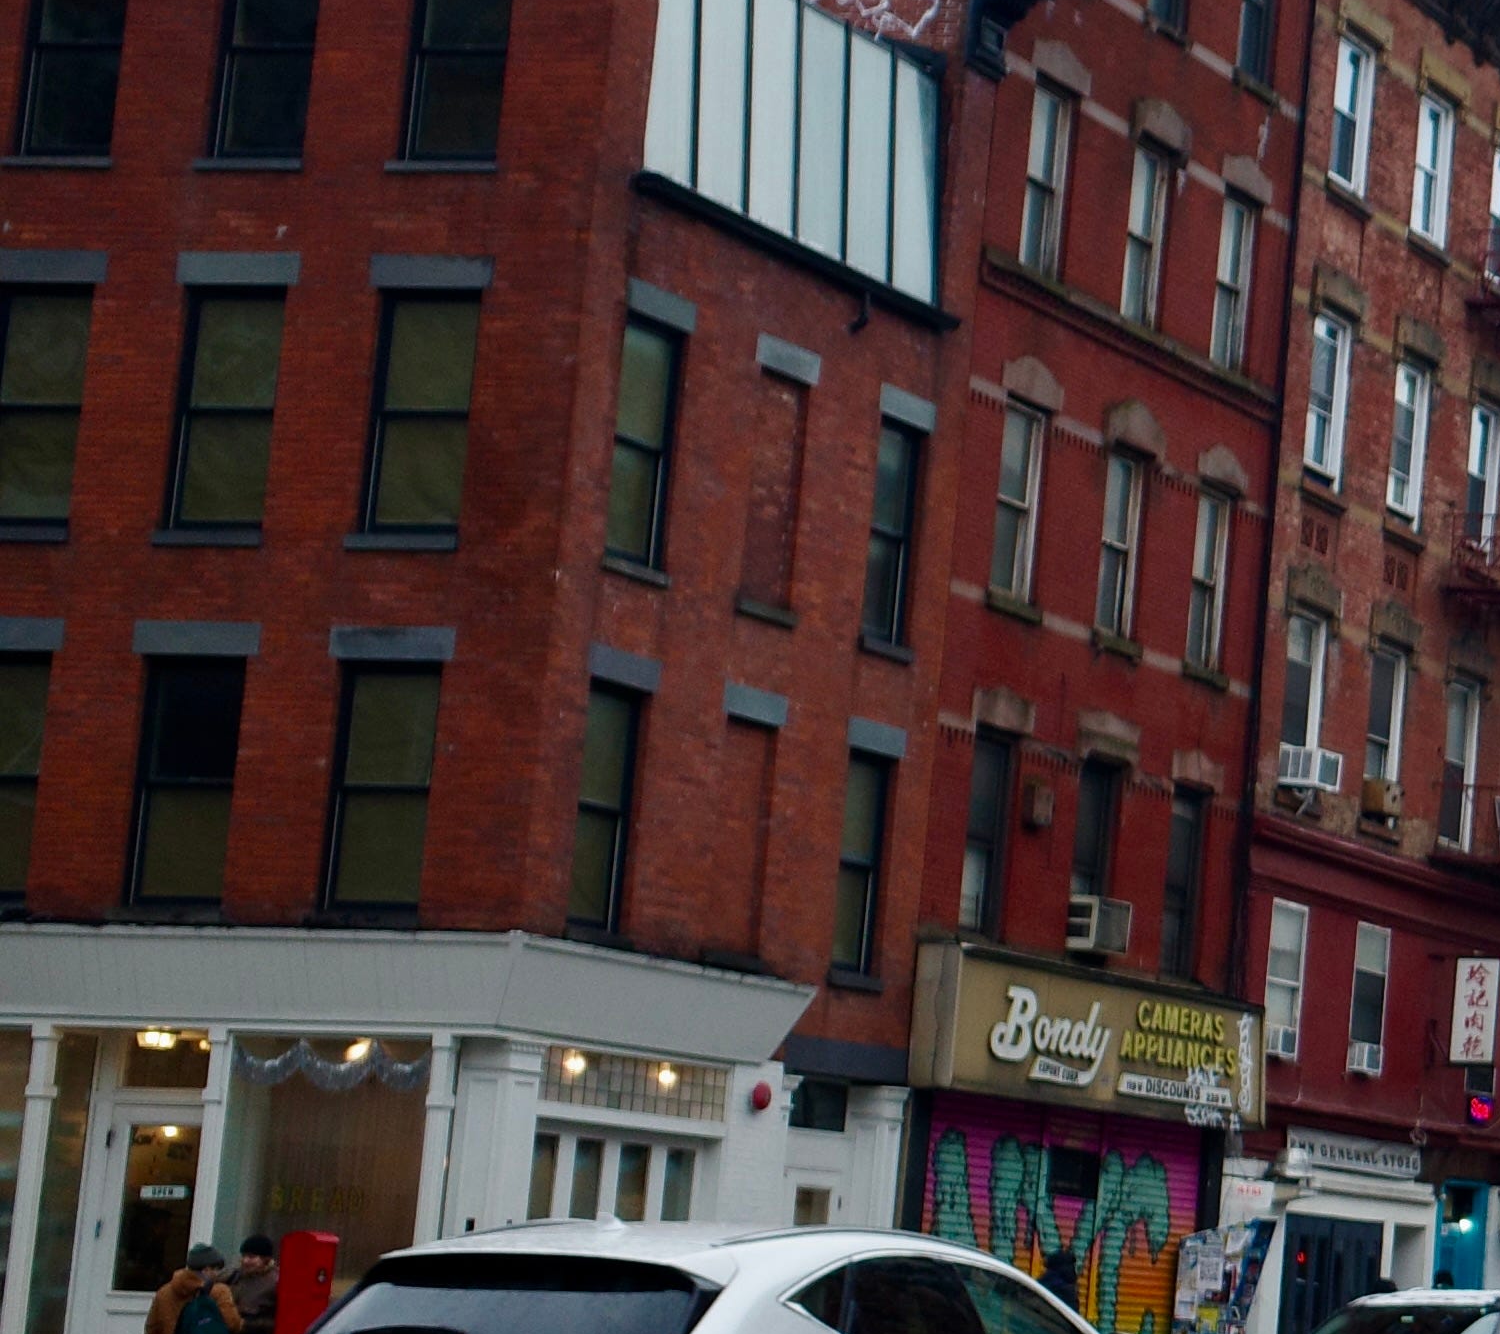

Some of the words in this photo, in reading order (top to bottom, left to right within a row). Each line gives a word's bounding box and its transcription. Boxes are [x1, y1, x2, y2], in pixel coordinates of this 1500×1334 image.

[990, 985, 1111, 1079] Bondy
[1138, 1000, 1224, 1041] CAMERAS
[1120, 1031, 1237, 1076] APPLIANCES
[1145, 1078, 1200, 1101] DISCOUNTS
[1320, 1144, 1377, 1165] GENERAL
[1383, 1153, 1419, 1172] STORE
